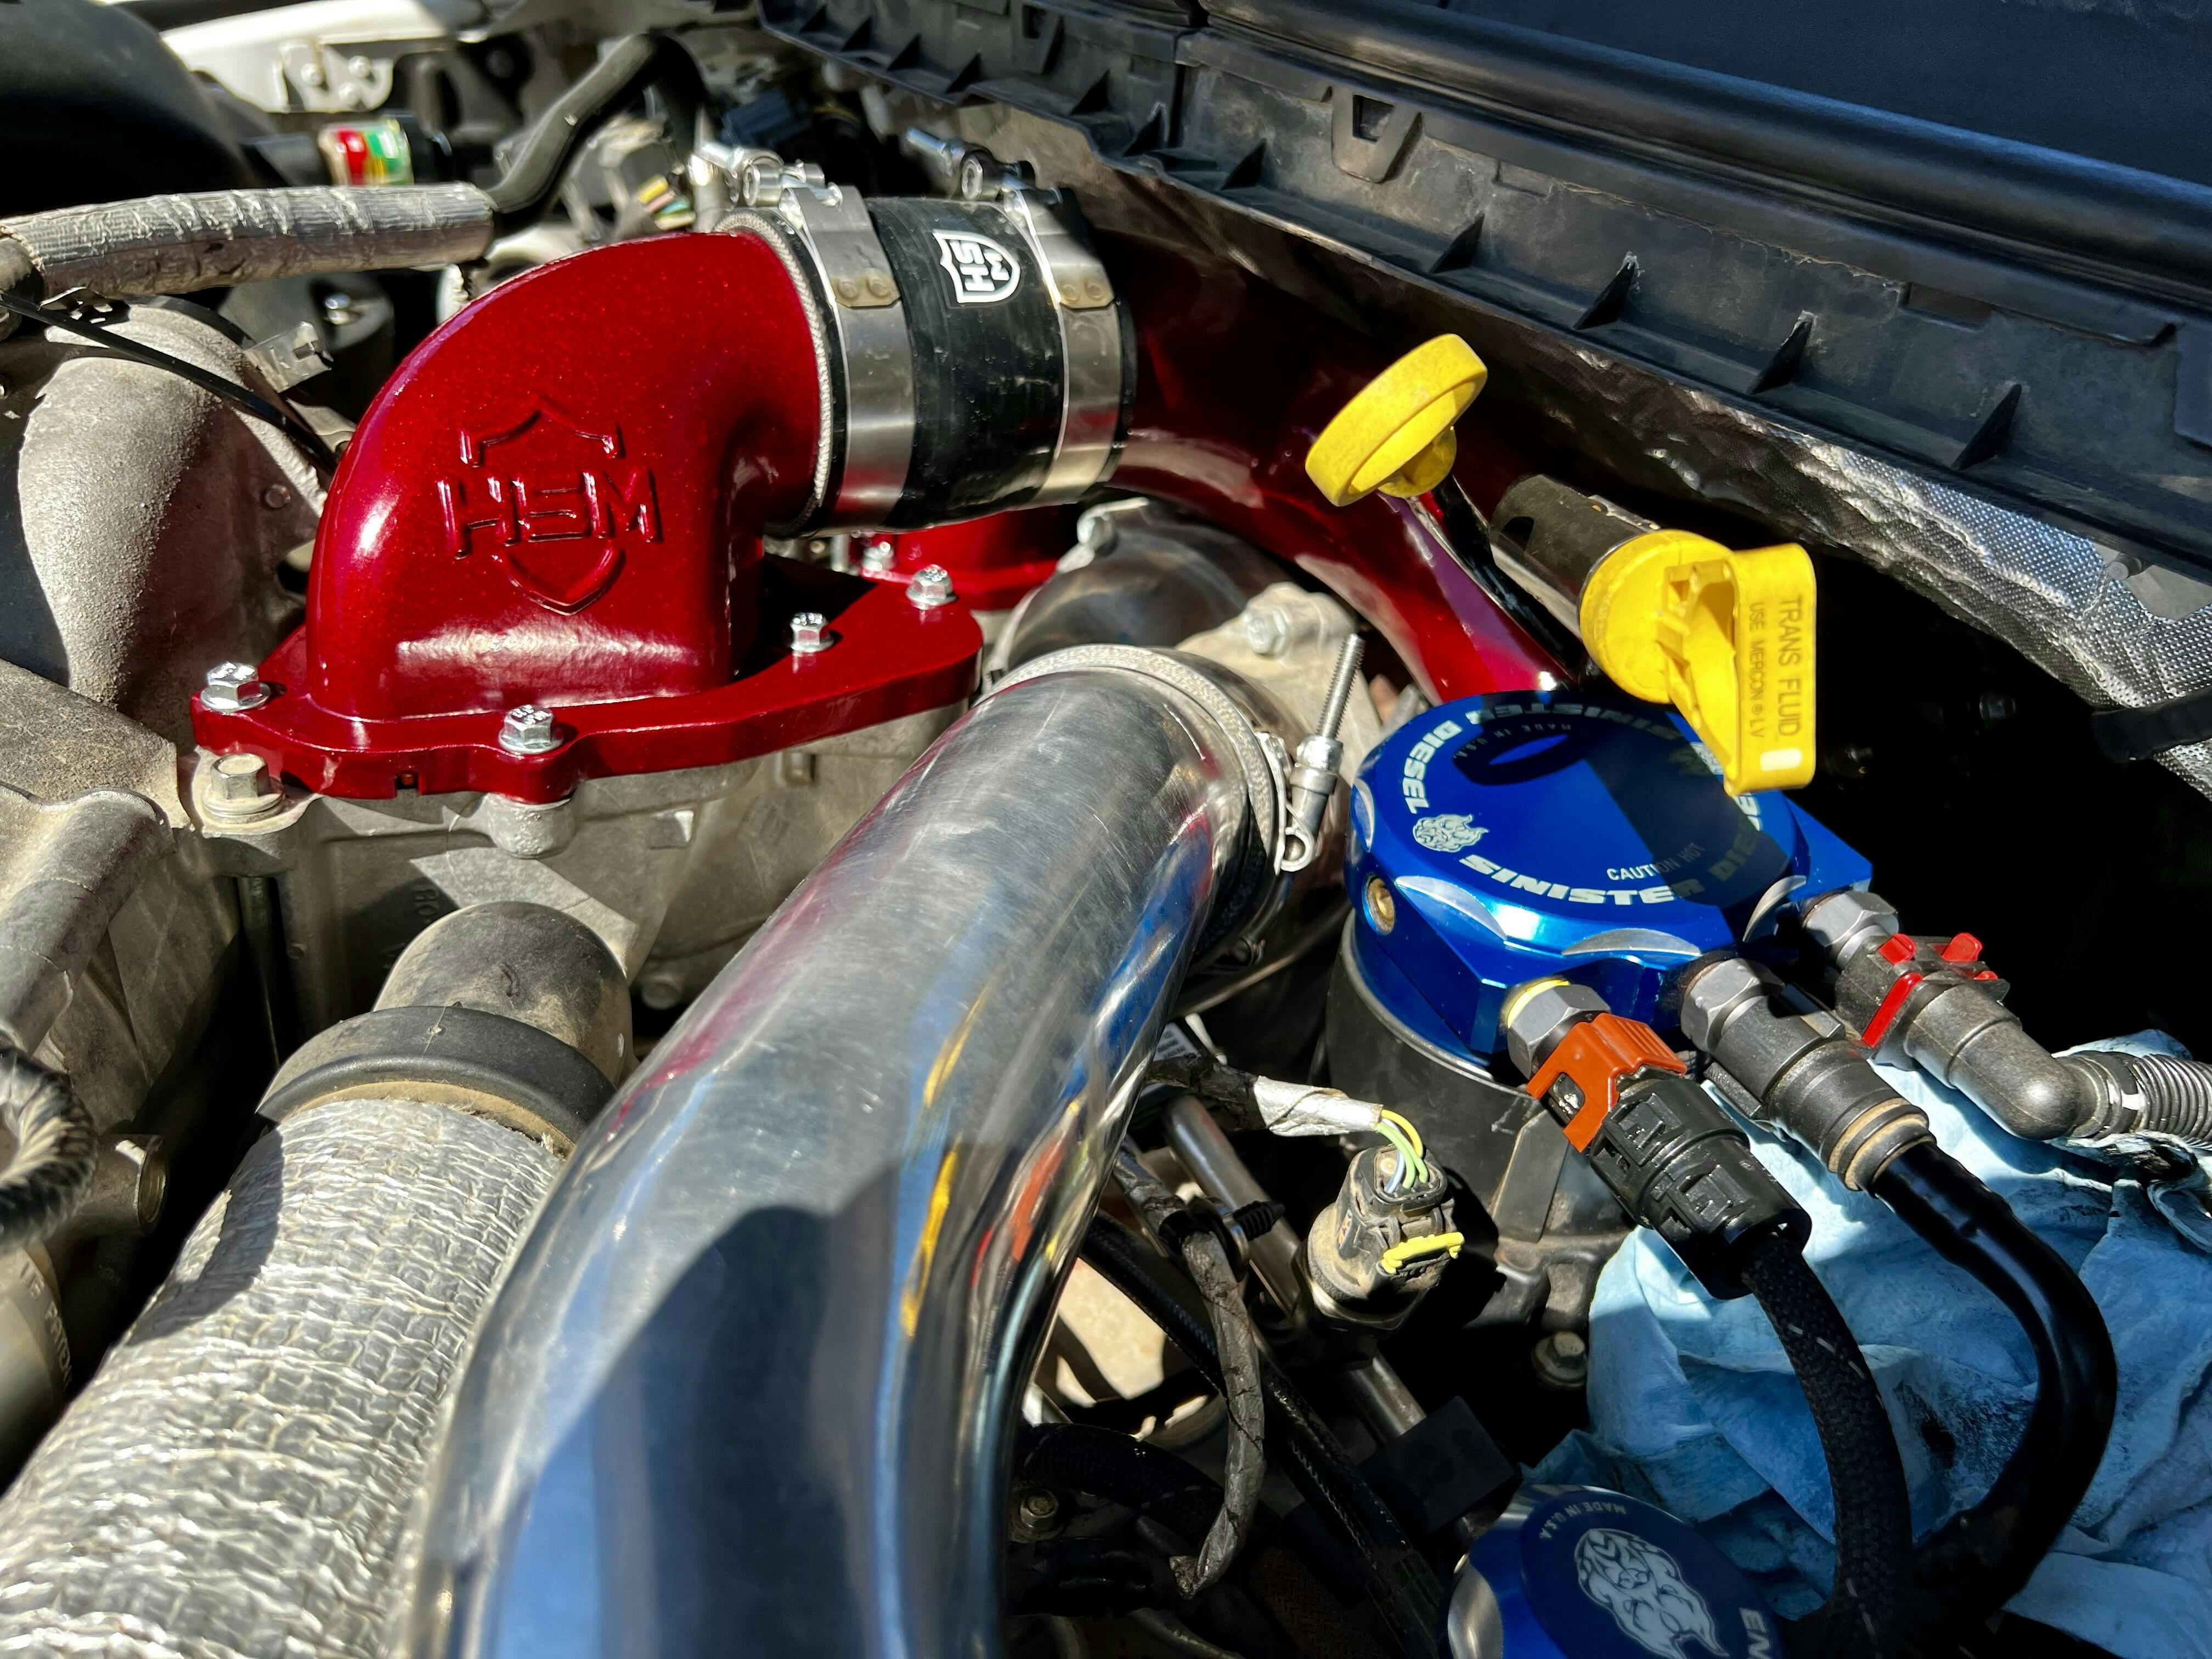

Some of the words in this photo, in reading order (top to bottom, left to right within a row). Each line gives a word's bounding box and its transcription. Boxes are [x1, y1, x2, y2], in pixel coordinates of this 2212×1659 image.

[437, 470, 664, 560] HSM
[1748, 601, 1765, 631] USE
[1778, 595, 1802, 667] TRANS
[1748, 640, 1765, 701] MERCON
[1465, 702, 1683, 741] SINISTER
[1778, 678, 1801, 736] FLUID
[1493, 728, 1512, 738] IN
[1521, 723, 1571, 732] MADE
[1402, 720, 1463, 814] DIESEL
[1459, 854, 1706, 906] SINISTER
[1707, 792, 1760, 882] DIESE
[1606, 858, 1681, 881] CAUTION
[1683, 842, 1706, 863] HOT
[1564, 1504, 1582, 1516] IN
[1582, 1501, 1627, 1515] MADE
